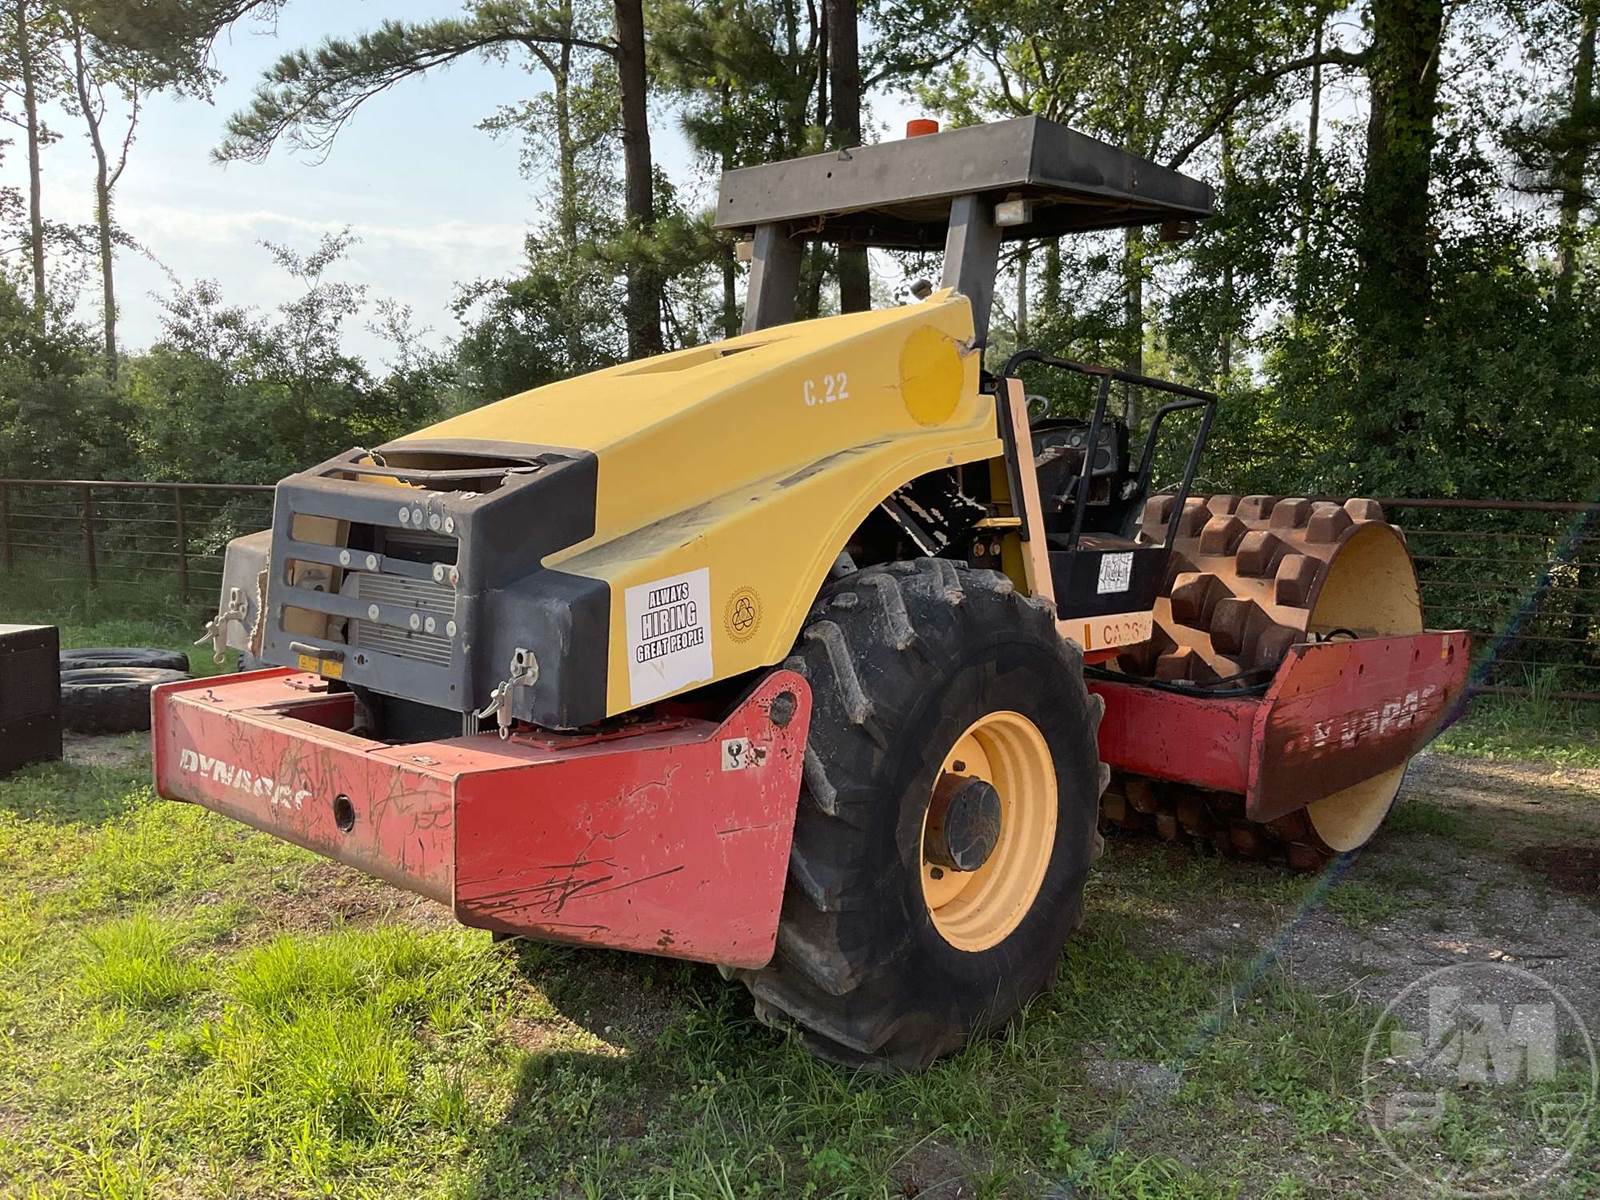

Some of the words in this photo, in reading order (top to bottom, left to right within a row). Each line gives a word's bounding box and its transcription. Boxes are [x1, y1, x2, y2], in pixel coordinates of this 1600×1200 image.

[803, 371, 849, 406] C.22
[649, 582, 689, 609] ALWAYS
[641, 601, 697, 641] HIRING
[636, 637, 669, 663] GREAT
[670, 627, 704, 653] PEOPLE
